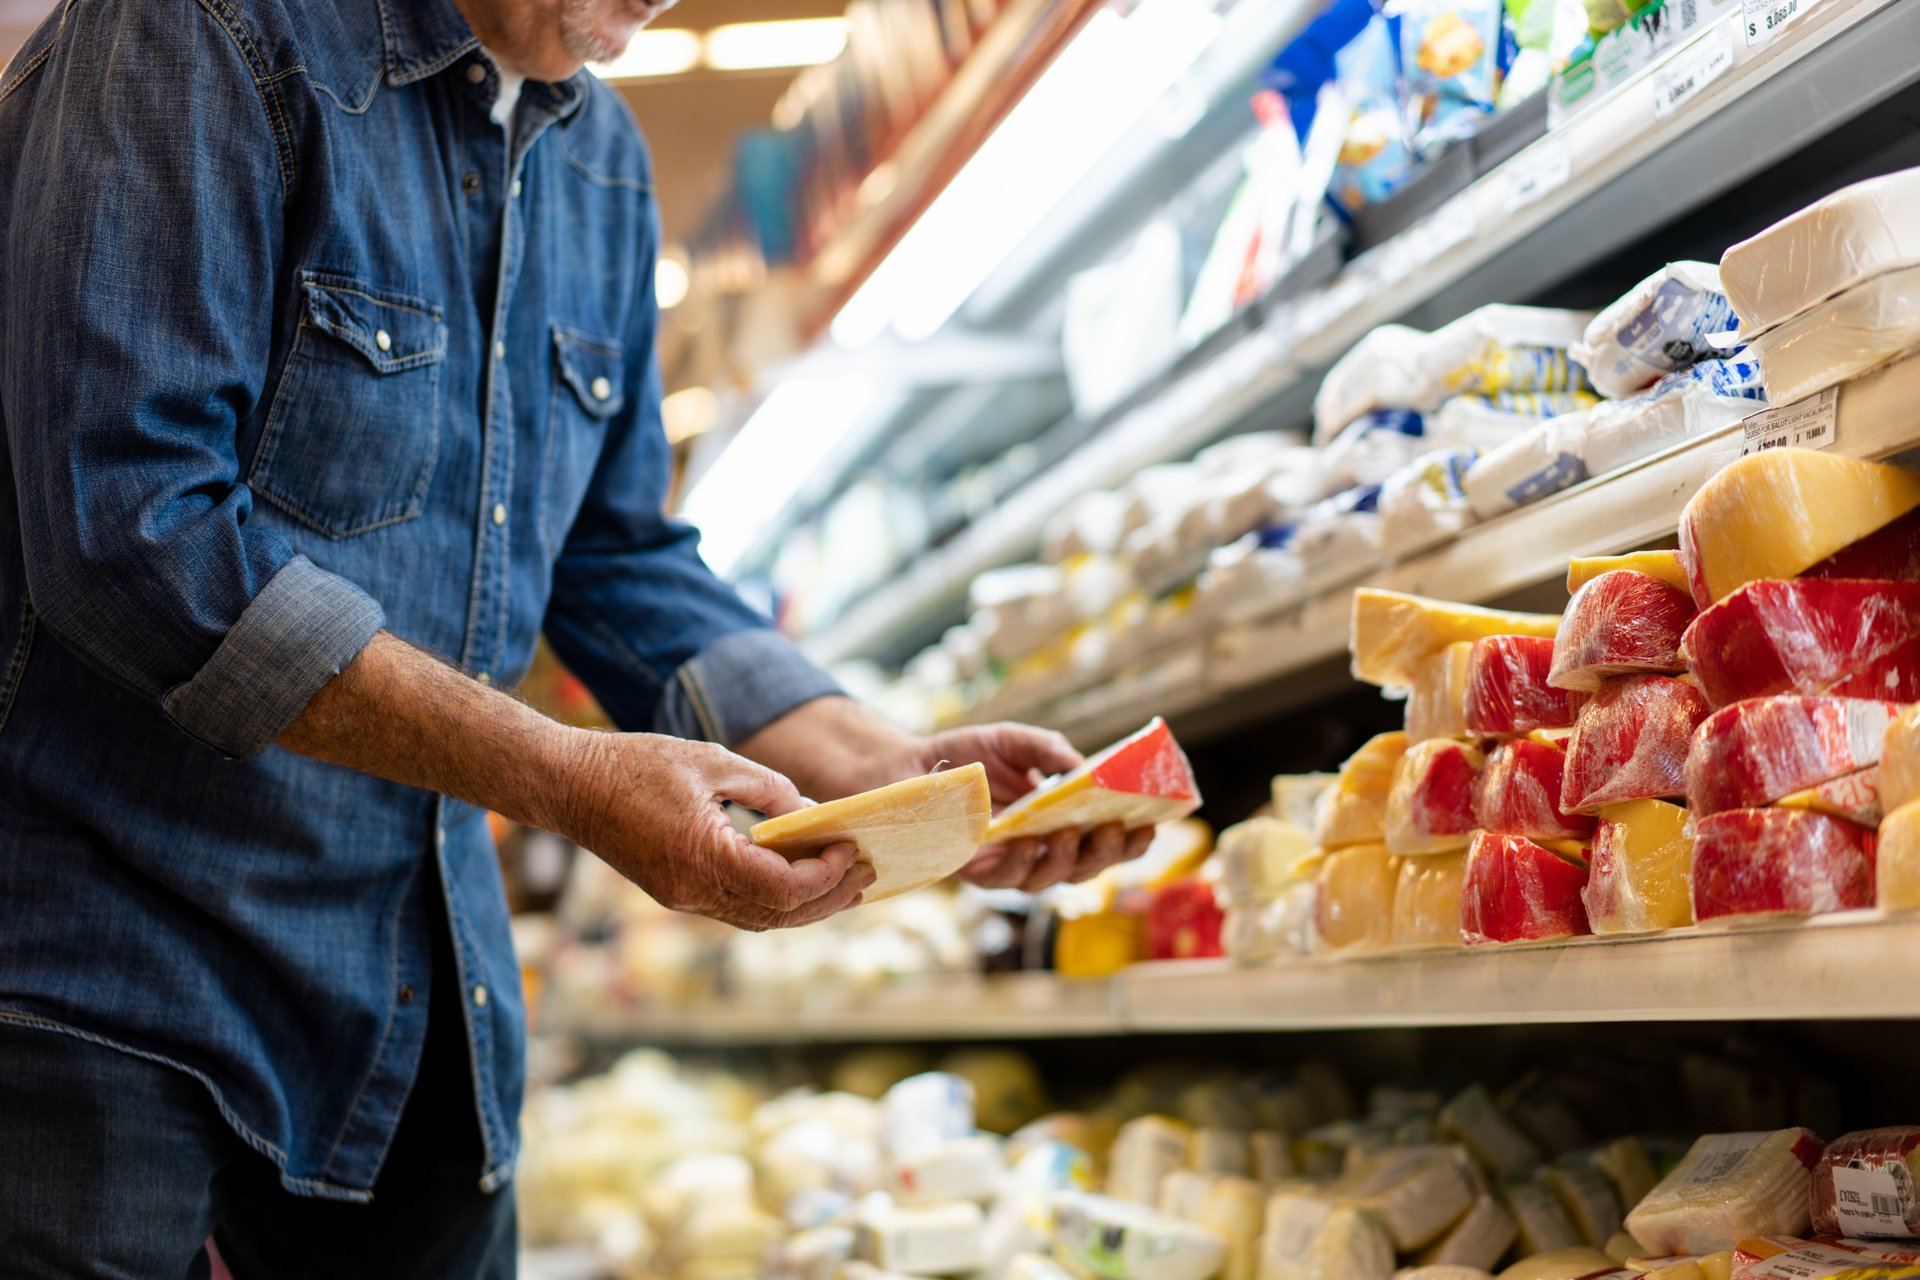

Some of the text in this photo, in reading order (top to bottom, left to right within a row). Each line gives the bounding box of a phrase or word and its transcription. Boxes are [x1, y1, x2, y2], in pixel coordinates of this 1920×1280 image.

[1748, 22, 1757, 37] $
[1746, 428, 1761, 439] QUESO
[1761, 424, 1771, 433] POR
[1771, 418, 1788, 430] SALUT
[1788, 414, 1803, 425] LIGHT
[1796, 434, 1800, 444] $
